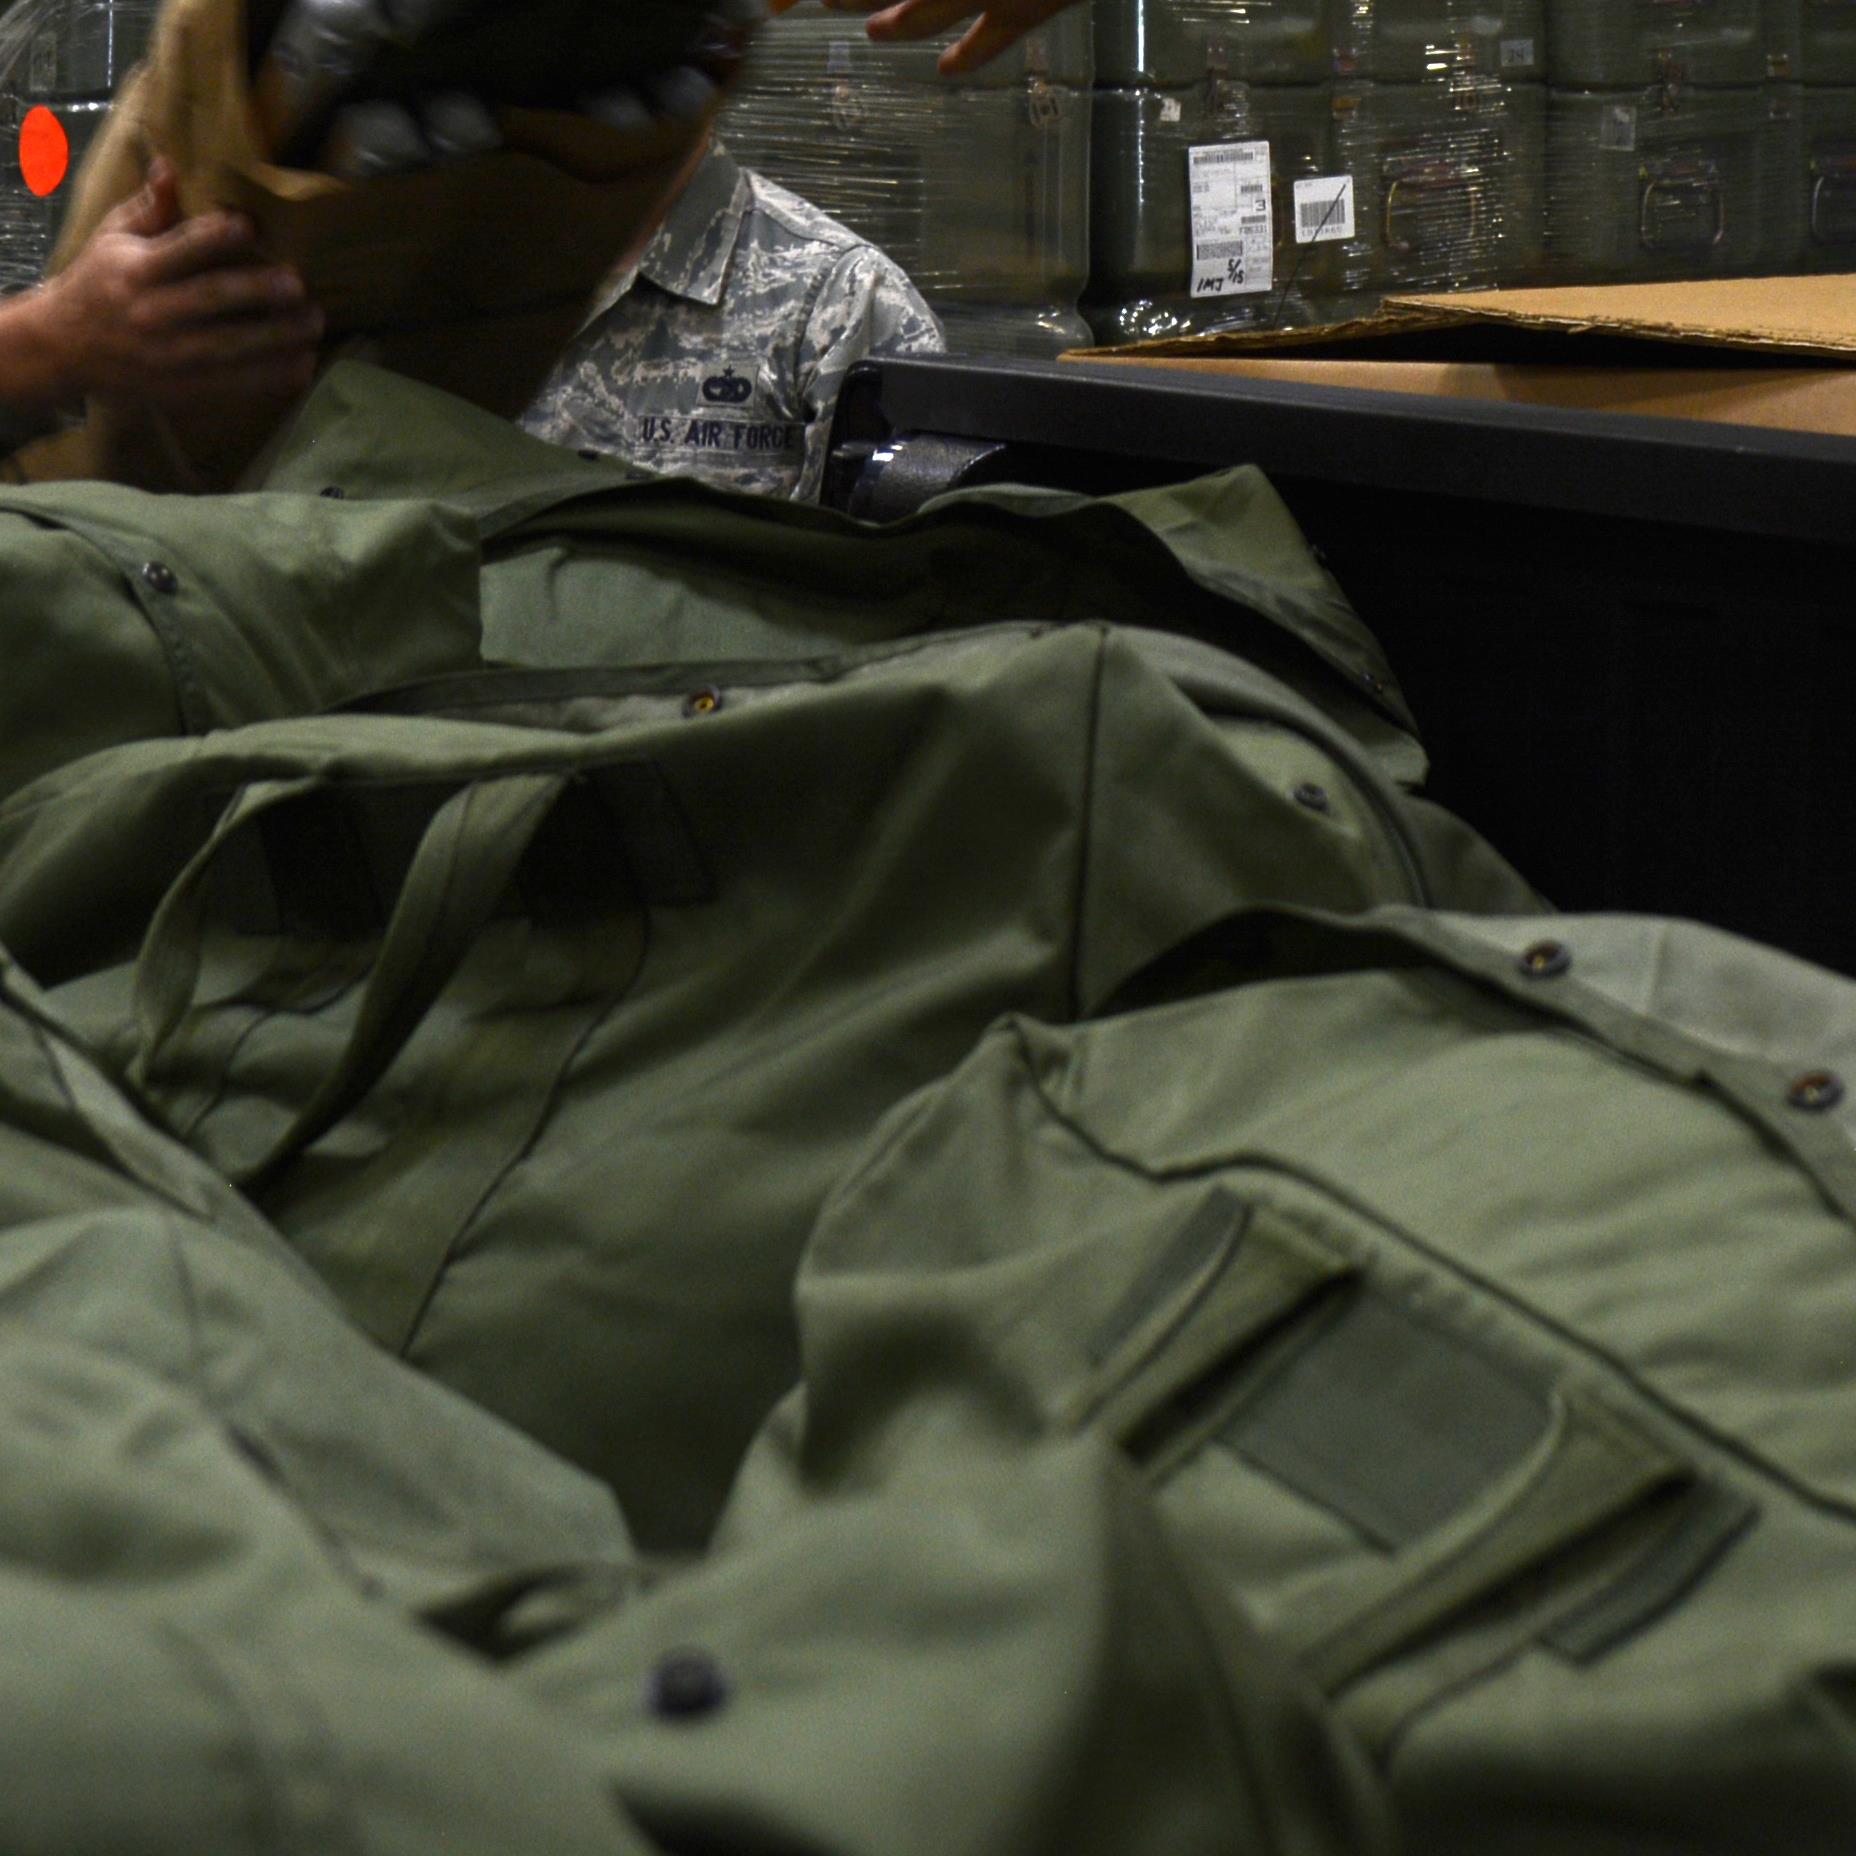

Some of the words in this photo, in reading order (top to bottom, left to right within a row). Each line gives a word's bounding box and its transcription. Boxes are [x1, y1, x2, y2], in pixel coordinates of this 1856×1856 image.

[642, 416, 674, 443] U.S.
[684, 418, 721, 447] AIR
[733, 420, 796, 450] FORCE
